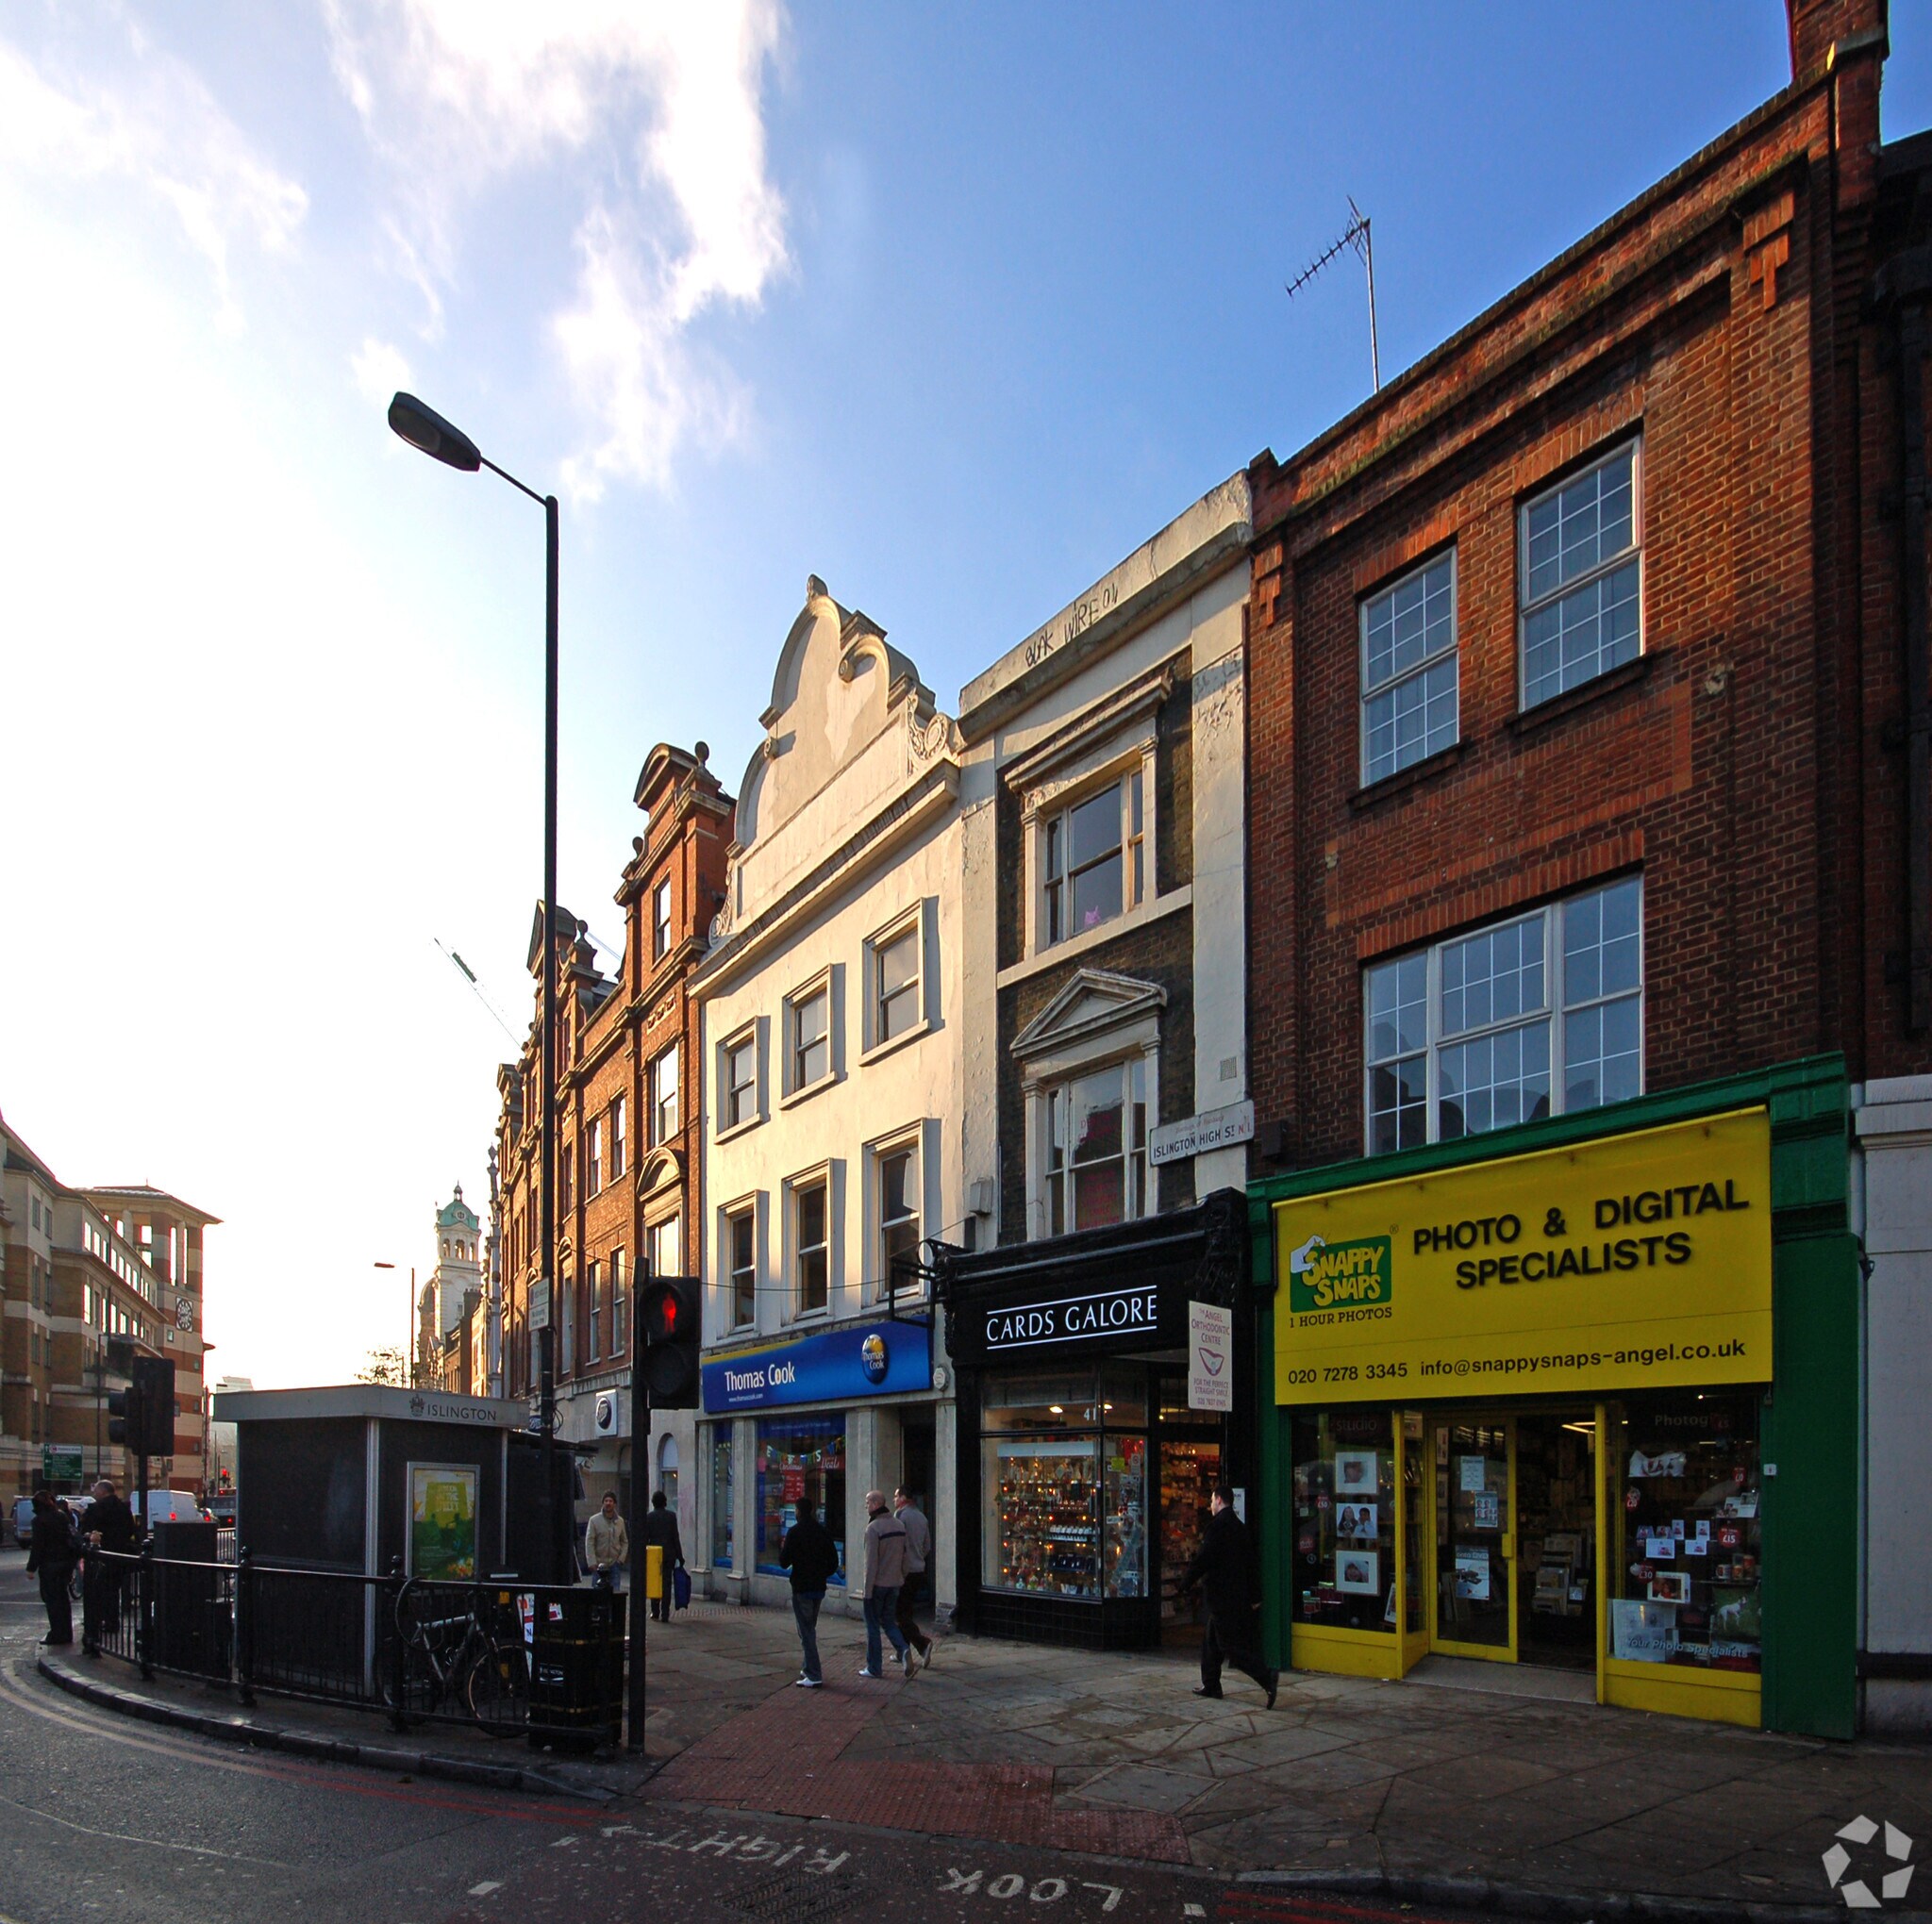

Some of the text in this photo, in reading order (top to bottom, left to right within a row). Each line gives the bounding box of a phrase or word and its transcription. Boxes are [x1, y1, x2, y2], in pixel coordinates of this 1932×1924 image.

[1153, 1136, 1196, 1159] ISLINGTON
[1199, 1129, 1221, 1146] HIGH
[1412, 1178, 1750, 1256] PHOTO & DIGITAL
[1301, 1245, 1385, 1286] SNAPPY
[1455, 1231, 1693, 1290] SPECIALISTS
[1313, 1274, 1381, 1307] SNAPS
[986, 1294, 1158, 1342] CARDS GALORE
[1205, 1309, 1224, 1322] ANGEL
[1290, 1307, 1392, 1328] 1 HOUR PHOTOS
[1191, 1319, 1230, 1335] ORTHODONTIC
[1201, 1333, 1222, 1346] CENTRE
[862, 1351, 885, 1362] Thomas
[869, 1360, 885, 1370] Cook
[1288, 1338, 1746, 1385] 020 7278 3345 info@snappysnaps-angel.co.uk
[724, 1361, 795, 1392] Thomas Cook
[427, 1403, 497, 1421] ISLINGTON
[1084, 1408, 1097, 1421] 41
[1655, 1414, 1708, 1428] Photog
[1335, 1418, 1378, 1432] studio
[1723, 1534, 1736, 1543] £15
[1638, 1570, 1653, 1579] £30
[1653, 1639, 1684, 1652] Photo
[1688, 1643, 1749, 1658] Specialists
[640, 1828, 1124, 1912] LOOK RIGHT
